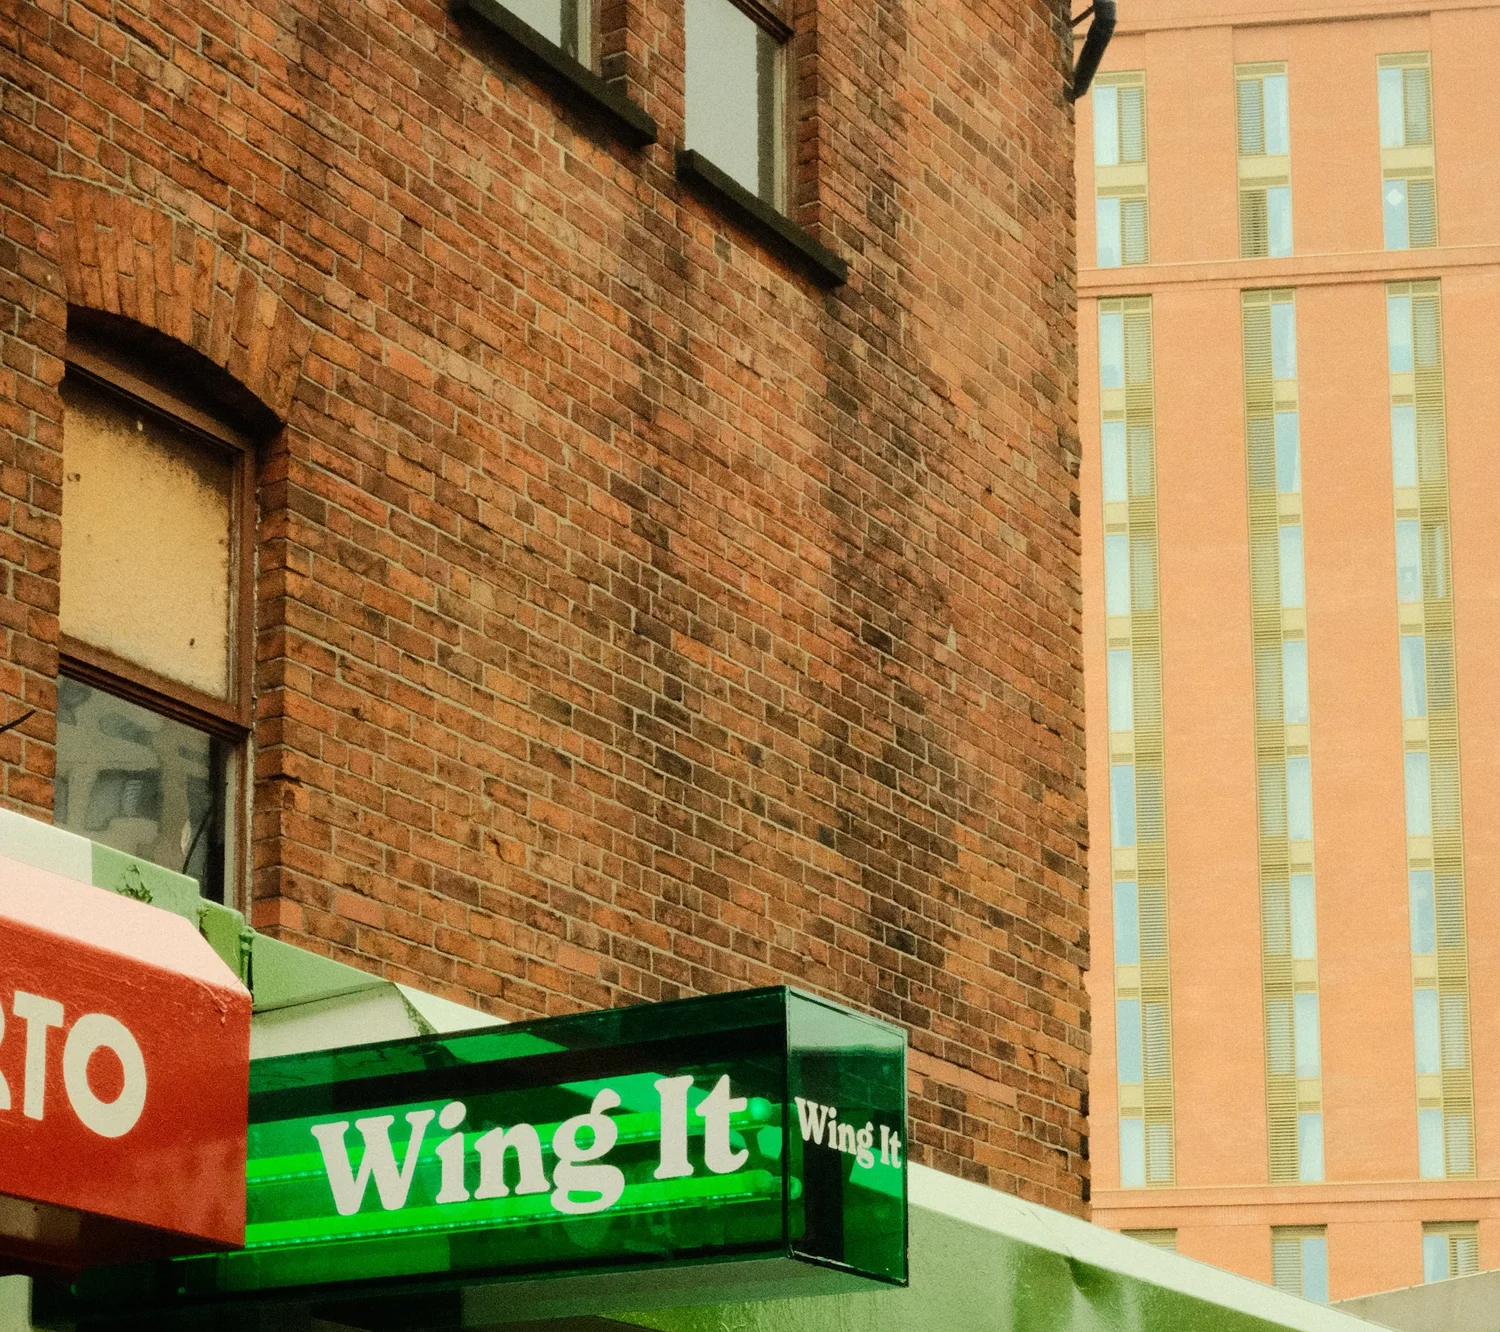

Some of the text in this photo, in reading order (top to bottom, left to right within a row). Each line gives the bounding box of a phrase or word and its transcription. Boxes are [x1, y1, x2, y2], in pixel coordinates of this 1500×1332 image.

[0, 990, 147, 1138] TO
[794, 1096, 902, 1169] Wing It
[310, 1074, 748, 1215] Wing It
